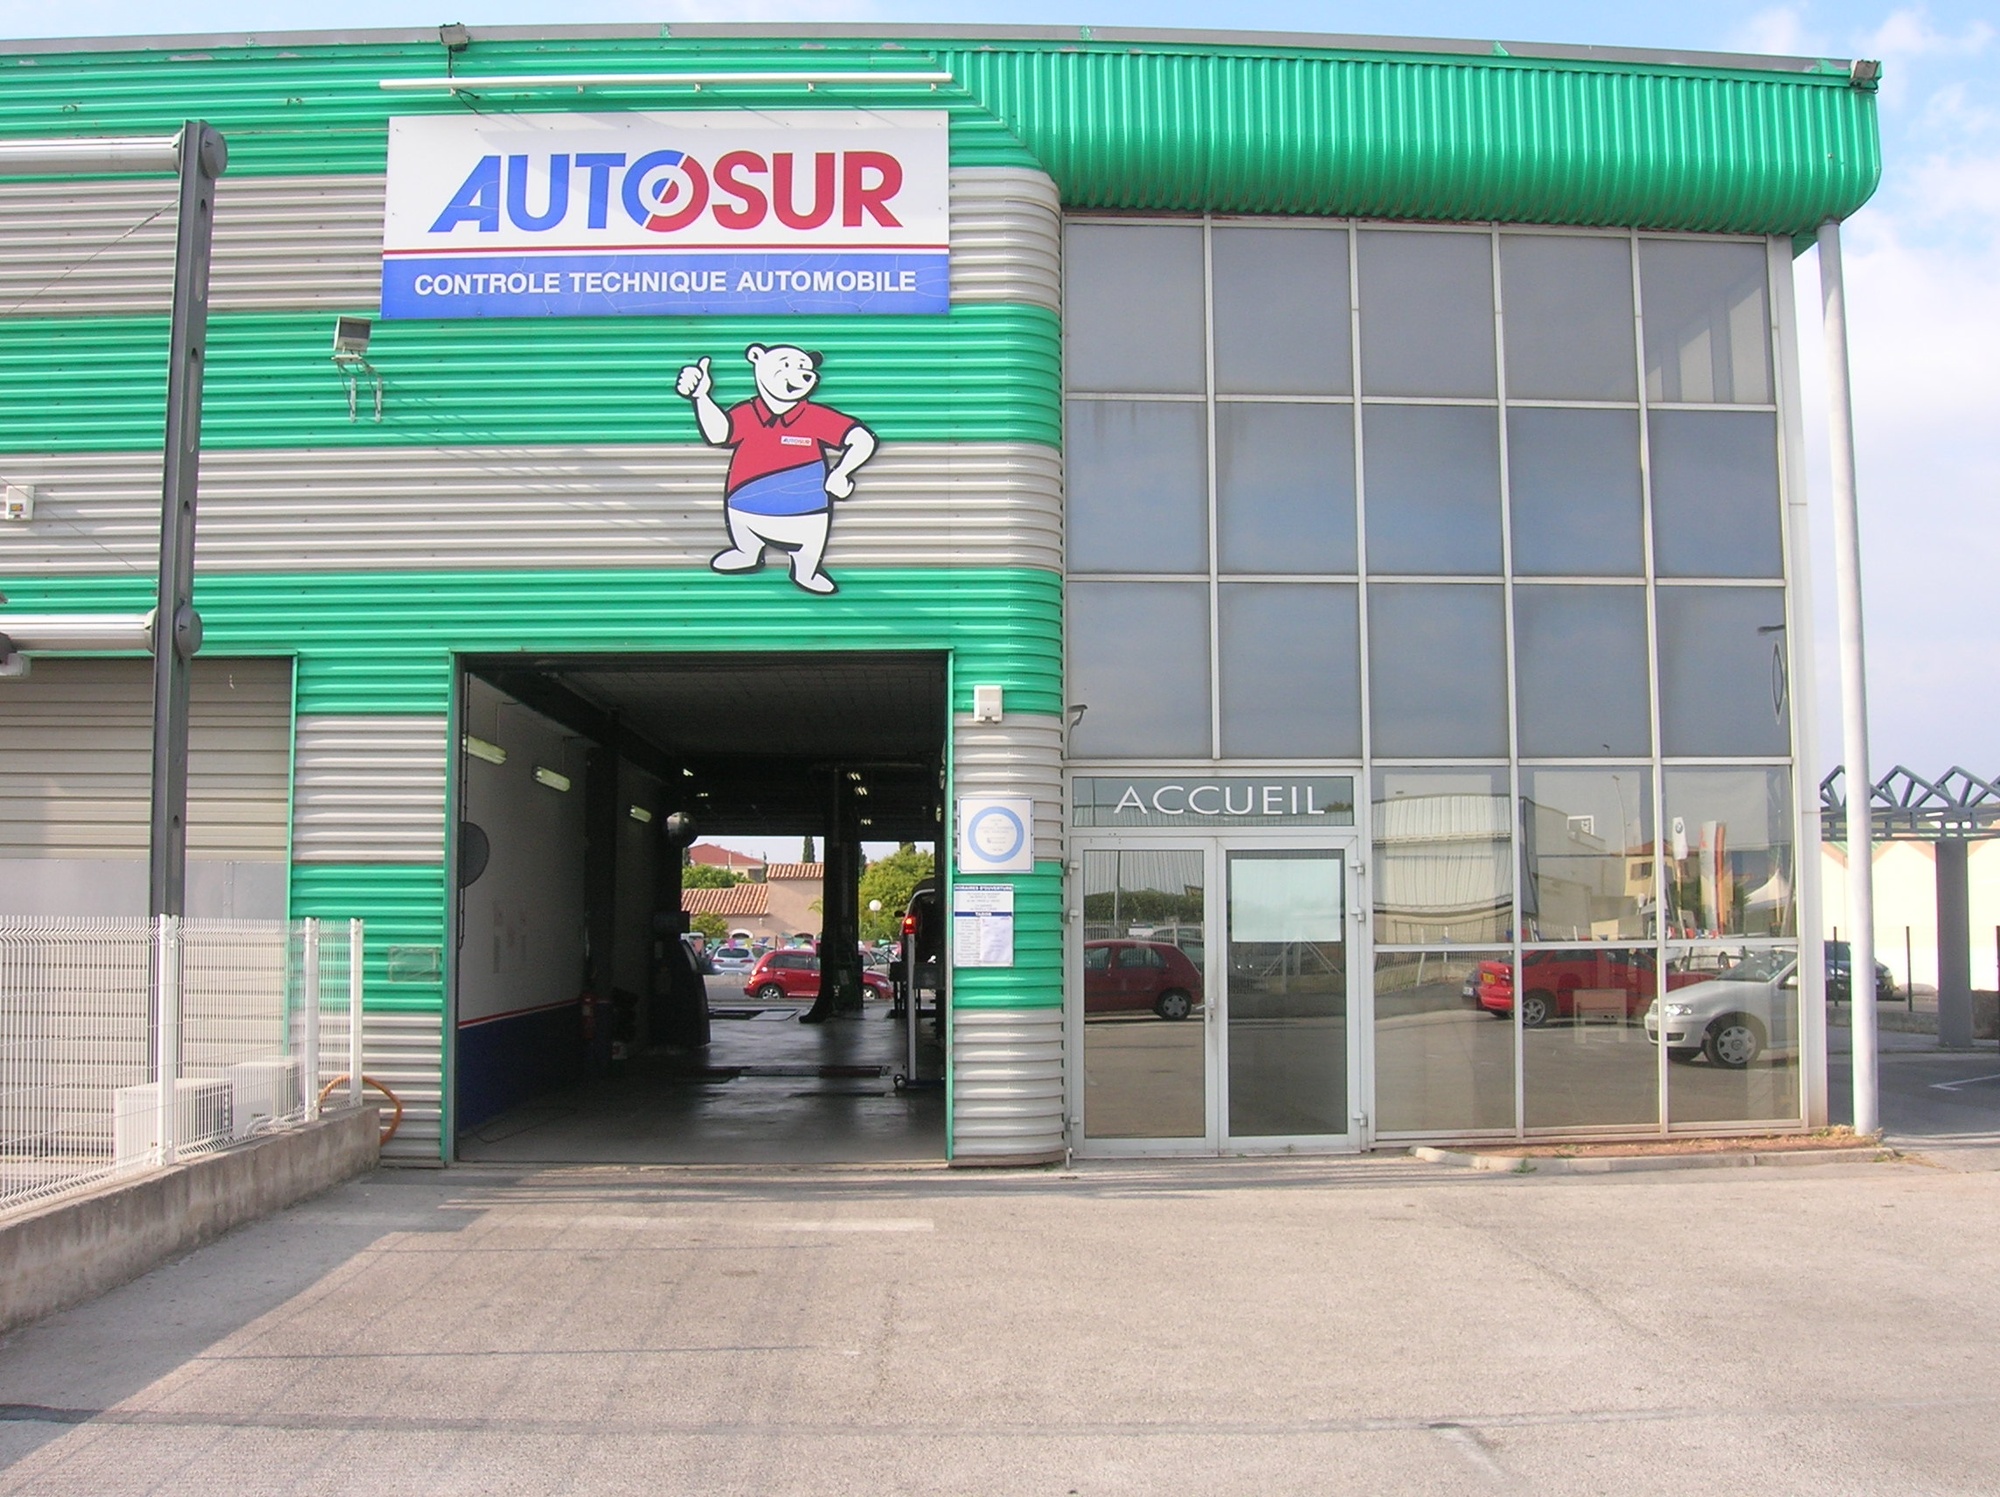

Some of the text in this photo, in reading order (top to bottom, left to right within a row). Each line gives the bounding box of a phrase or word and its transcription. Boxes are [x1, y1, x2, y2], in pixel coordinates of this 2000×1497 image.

[428, 150, 904, 233] AUTOSUR
[414, 270, 917, 296] CONTROLE TECHNIQUE AUTOMOBILE
[1113, 785, 1325, 815] ACCUEIL
